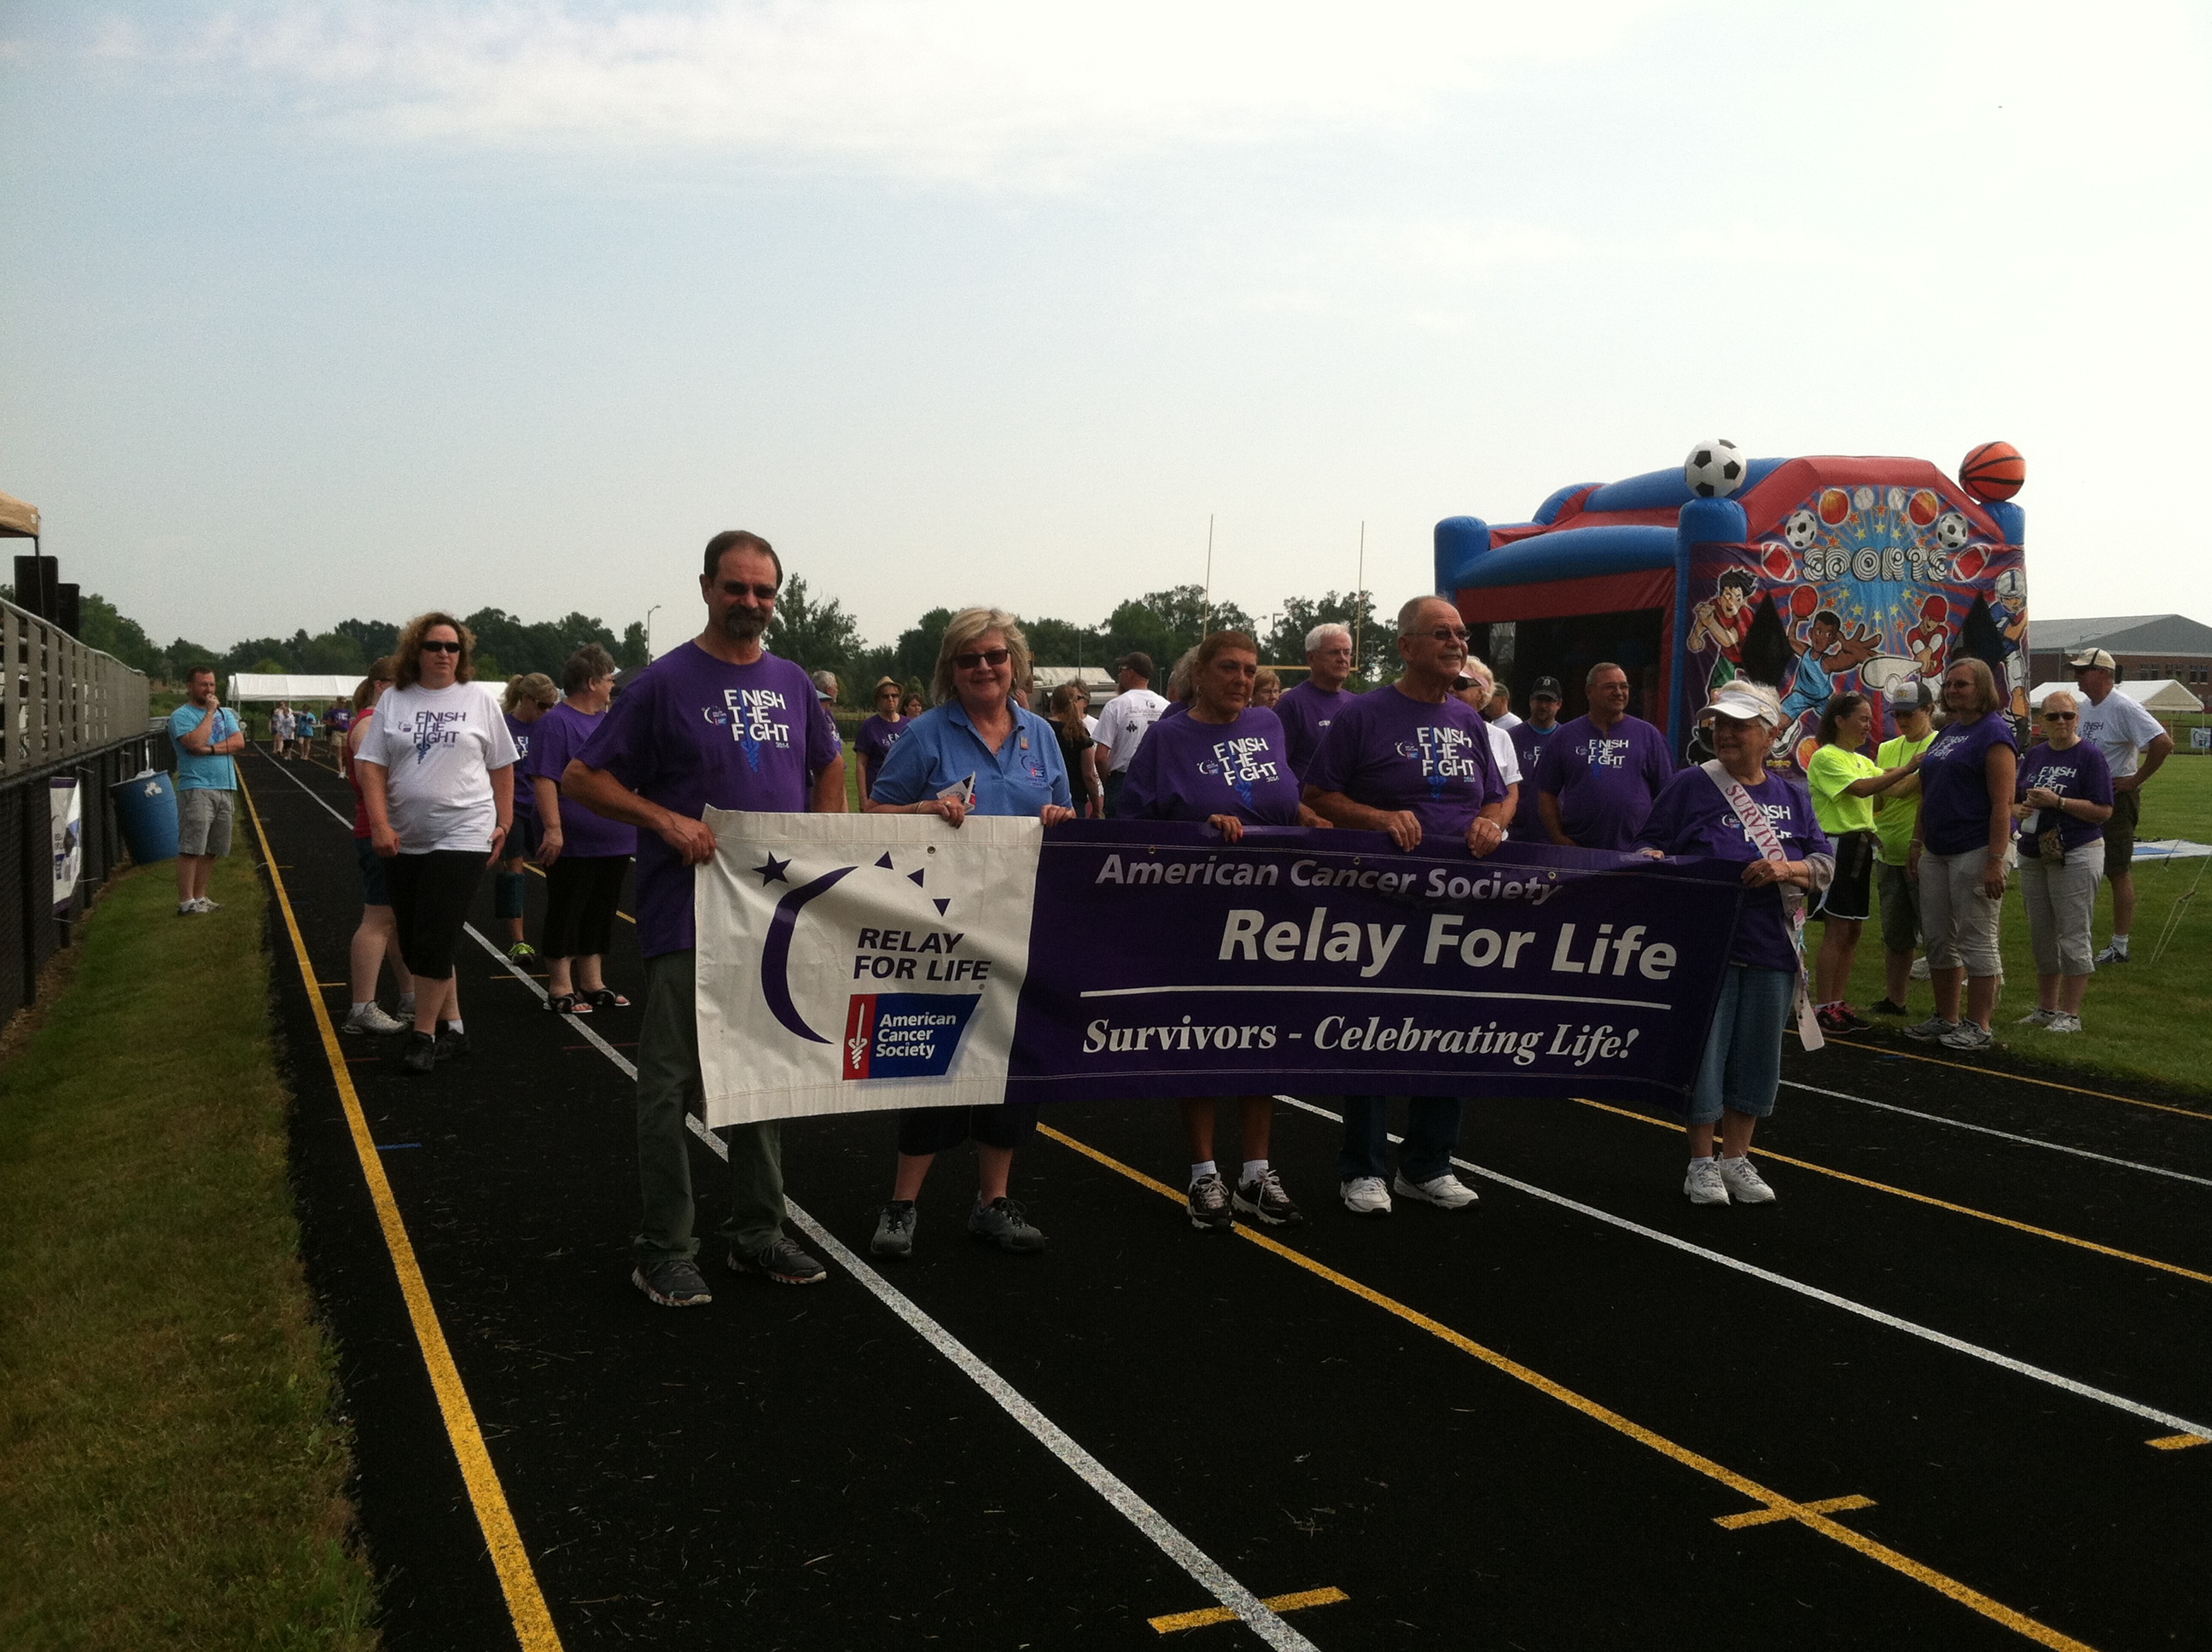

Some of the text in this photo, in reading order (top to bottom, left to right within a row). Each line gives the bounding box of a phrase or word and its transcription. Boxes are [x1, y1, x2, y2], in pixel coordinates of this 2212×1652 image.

[1802, 547, 1947, 582] SPORTS
[727, 706, 771, 724] THE
[415, 722, 445, 732] THE
[1218, 752, 1258, 771] THE
[1419, 742, 1459, 759] THE
[1726, 783, 1785, 862] SURVIVO
[1095, 854, 1563, 905] American Cancer Society
[857, 928, 964, 954] RELAY
[1217, 906, 1678, 980] Relay For Life
[853, 956, 992, 981] FOR LIFE
[879, 1012, 957, 1027] American
[877, 1029, 934, 1043] Cancer
[1082, 1015, 1278, 1054] Survivors
[1313, 1015, 1545, 1066] Celebrating
[1545, 1023, 1640, 1067] Life!
[876, 1042, 935, 1059] Society
